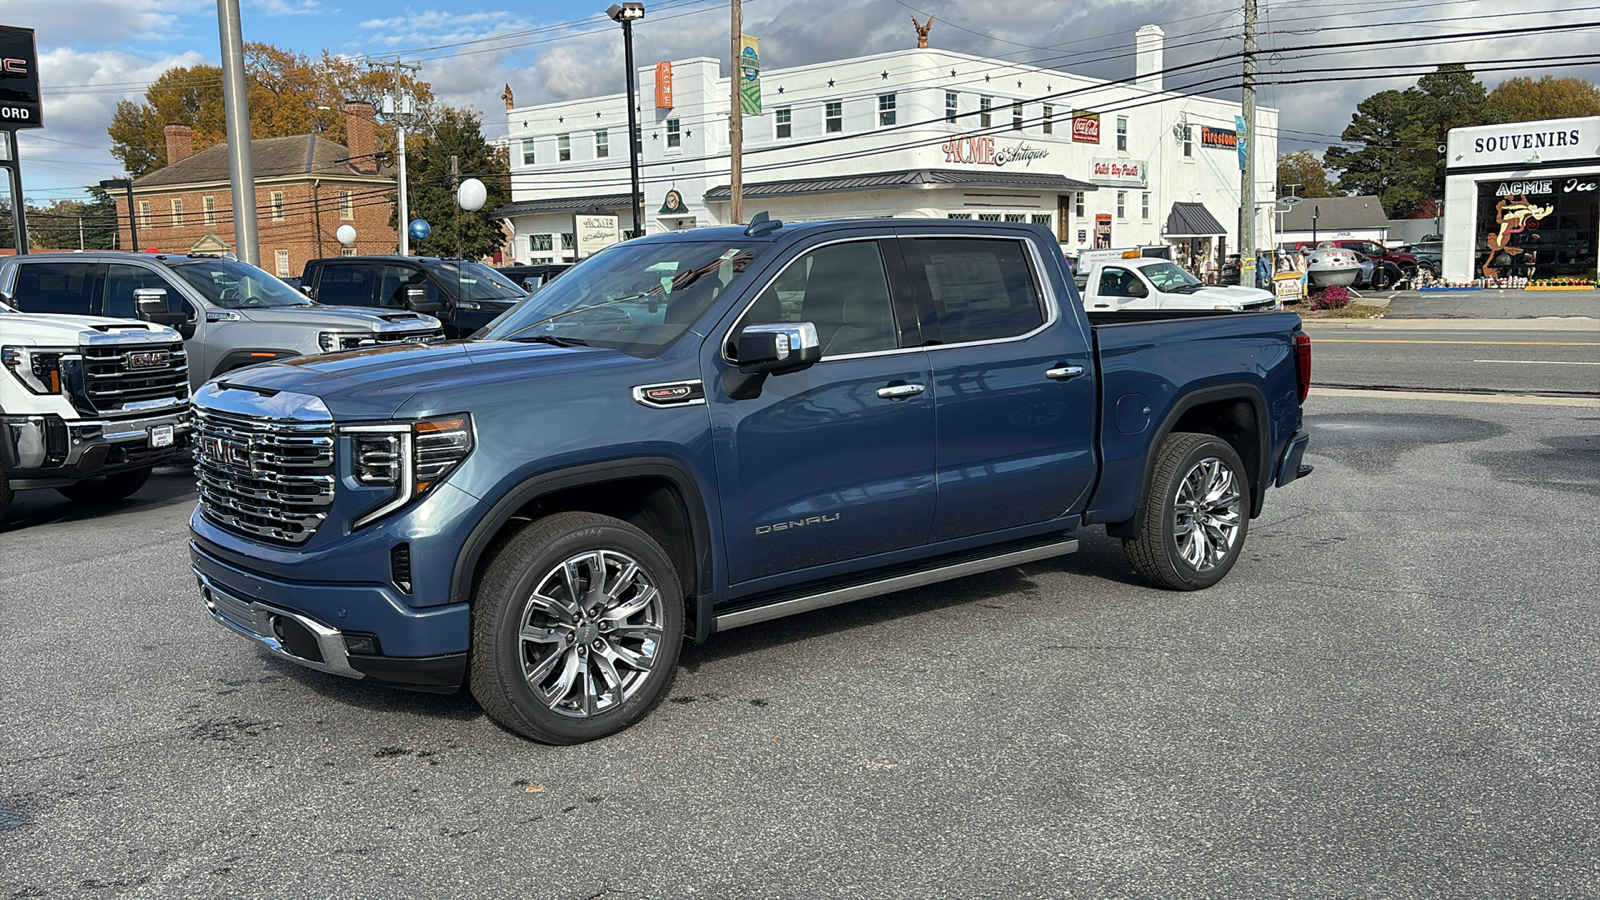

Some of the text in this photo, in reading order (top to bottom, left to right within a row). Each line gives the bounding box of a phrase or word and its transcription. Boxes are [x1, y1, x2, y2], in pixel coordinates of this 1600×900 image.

[1202, 126, 1237, 147] Firestone
[1475, 129, 1580, 153] SOUVENIRS
[942, 134, 1050, 167] ACME Antiques
[1094, 162, 1138, 178] Dutch Boy Paints
[1495, 178, 1598, 197] ACME Ice
[131, 352, 170, 367] GMC
[202, 437, 249, 468] GMC
[755, 512, 840, 535] DENALI
